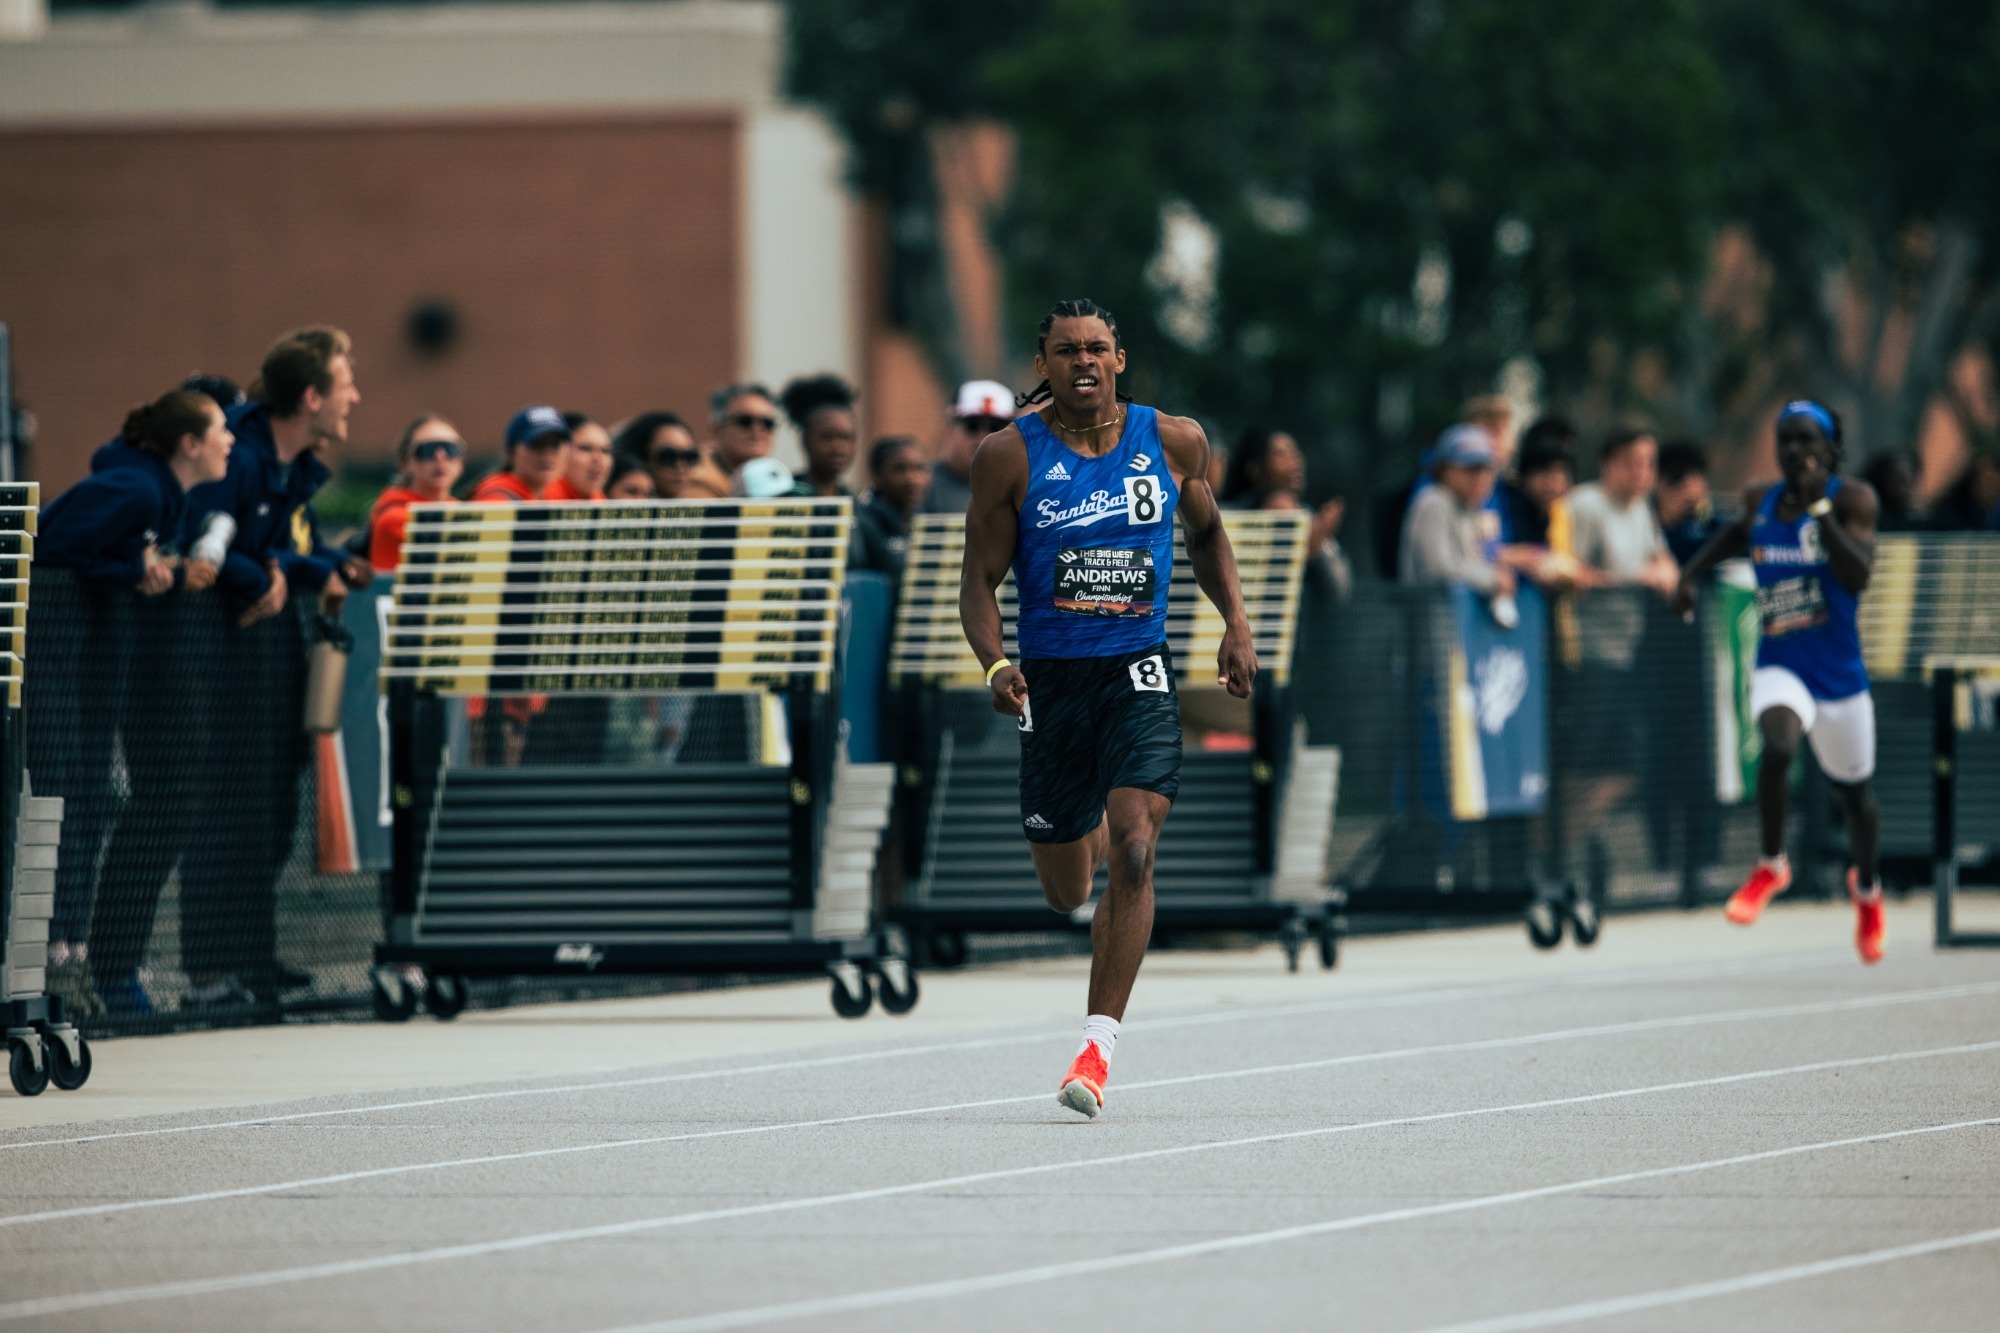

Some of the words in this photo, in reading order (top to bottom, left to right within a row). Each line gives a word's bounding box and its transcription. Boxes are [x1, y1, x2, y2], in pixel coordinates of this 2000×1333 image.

[1045, 473, 1072, 481] adidas
[1133, 478, 1156, 522] 8
[1080, 550, 1096, 558] THE
[1096, 550, 1111, 558] BIG
[1112, 551, 1134, 559] WEST
[1084, 558, 1105, 566] TRACK
[1112, 559, 1130, 567] FIELD
[1063, 568, 1147, 584] ANDREWS
[1074, 589, 1133, 604] Championships
[1137, 659, 1162, 688] 8
[1024, 820, 1054, 829] adidas
